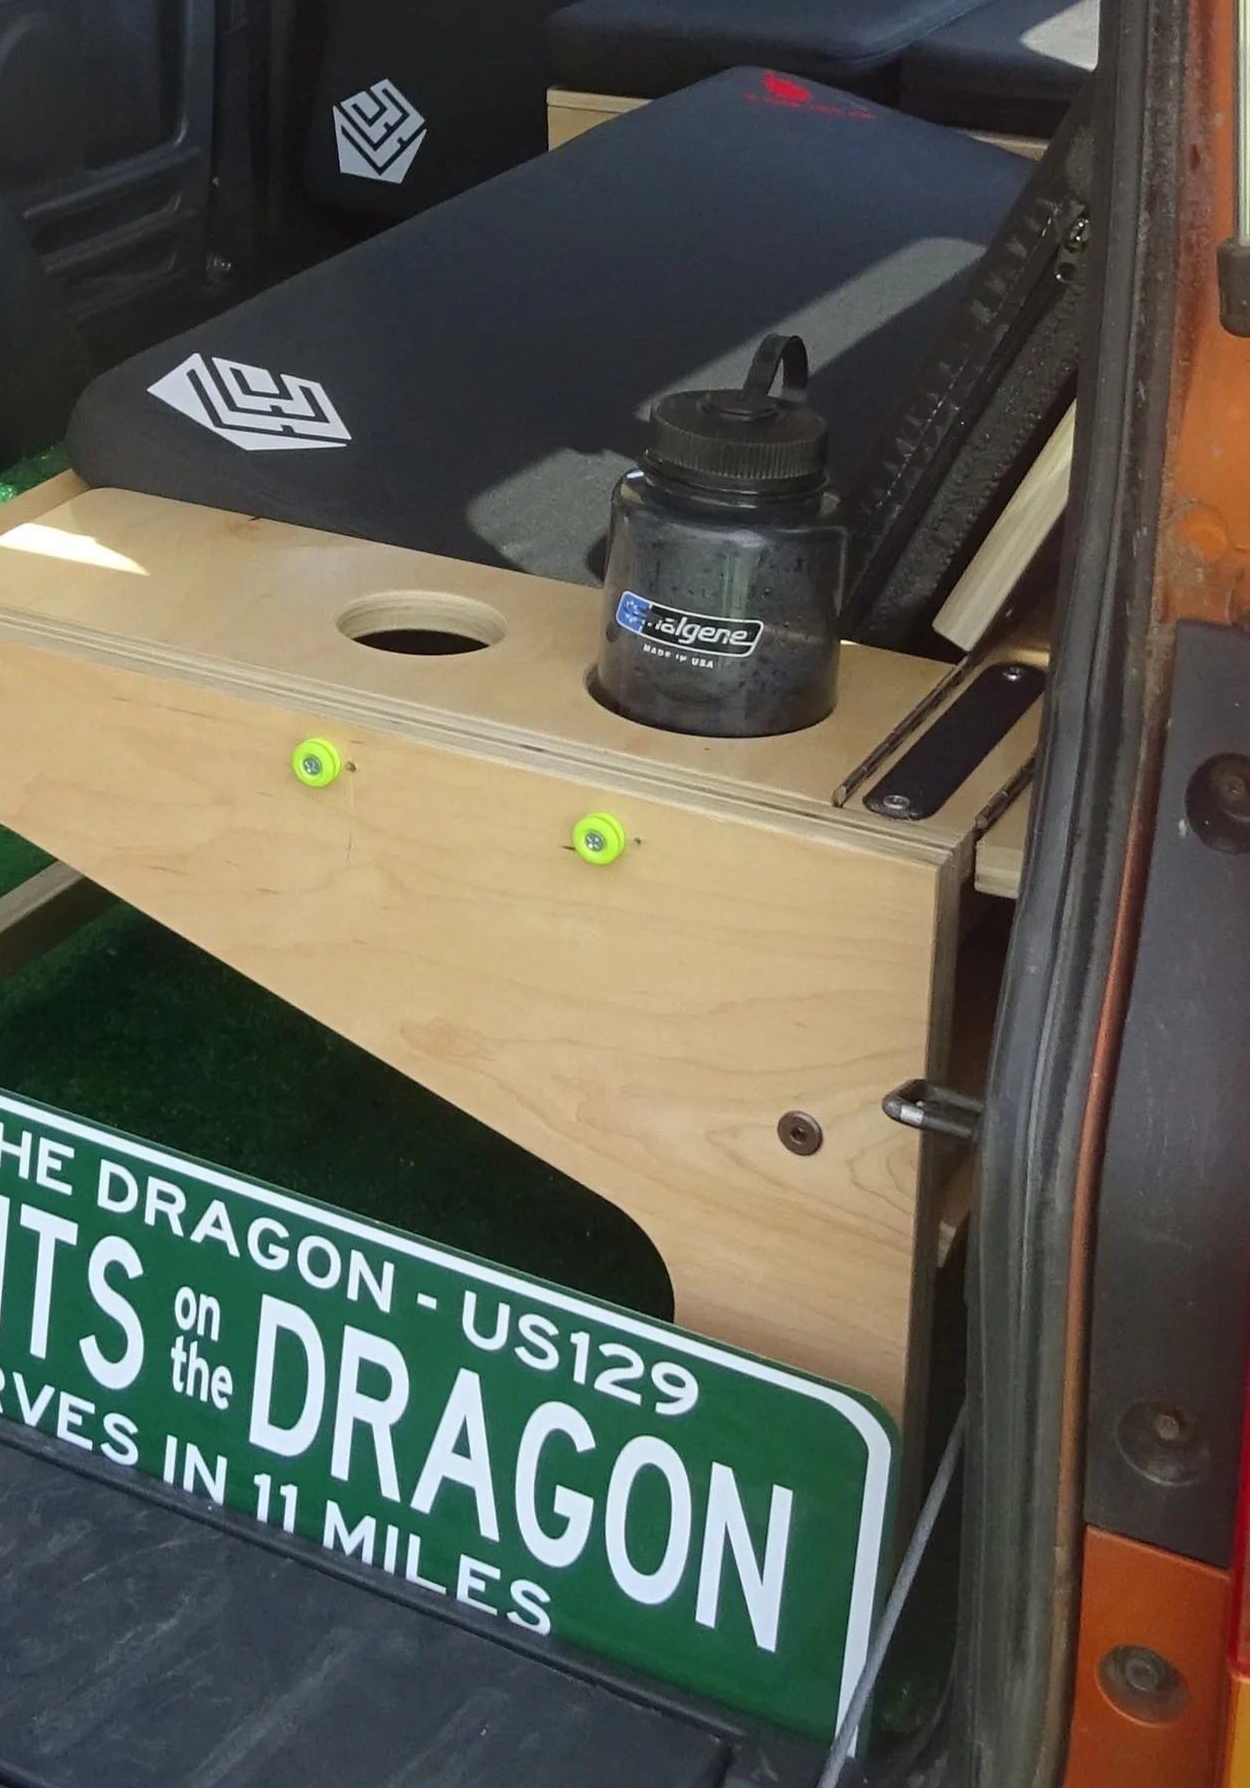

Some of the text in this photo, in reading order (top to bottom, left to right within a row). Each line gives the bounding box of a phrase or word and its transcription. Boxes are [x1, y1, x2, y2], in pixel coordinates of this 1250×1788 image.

[643, 645, 671, 658] MADE
[691, 657, 714, 668] USA
[97, 1159, 395, 1314] DRAGON
[462, 1290, 699, 1416] US129
[174, 1286, 221, 1342] on
[170, 1335, 233, 1410] the
[163, 1434, 228, 1506] IN
[253, 1473, 298, 1534] 11
[322, 1499, 551, 1636] MILES
[248, 1294, 794, 1653] DRAGON
